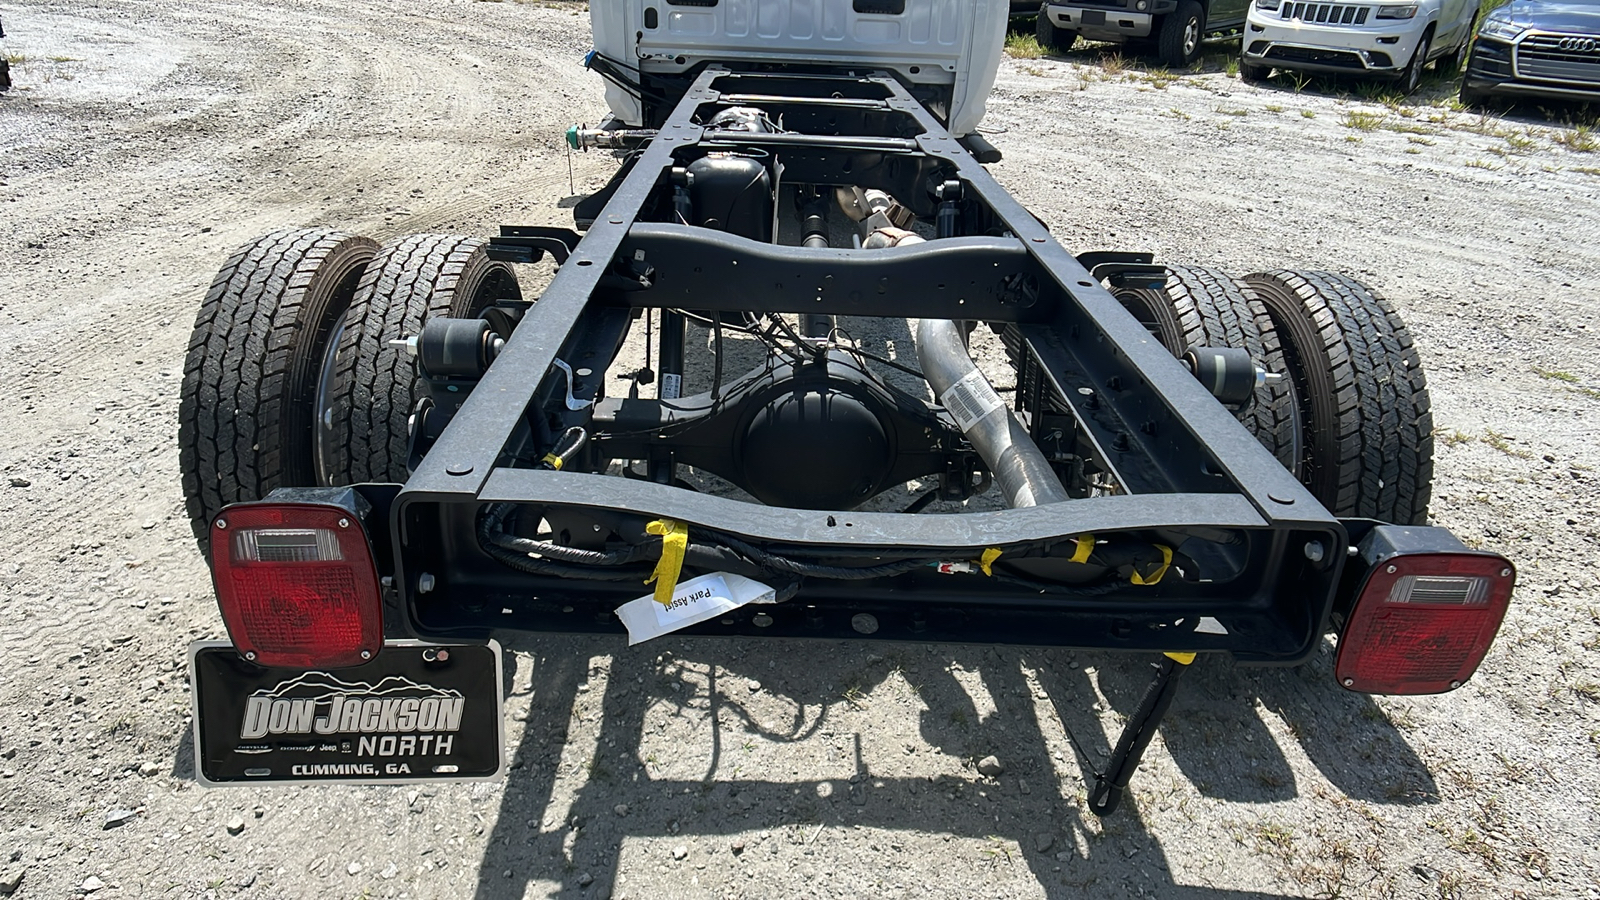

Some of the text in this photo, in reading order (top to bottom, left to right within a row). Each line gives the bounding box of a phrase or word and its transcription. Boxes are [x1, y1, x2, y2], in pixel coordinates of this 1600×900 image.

[664, 588, 711, 612] Park Assist
[240, 694, 465, 739] DON JACKSON
[319, 744, 337, 752] Jeep
[357, 735, 453, 757] NORTH
[291, 763, 411, 776] CUMMING, GA
